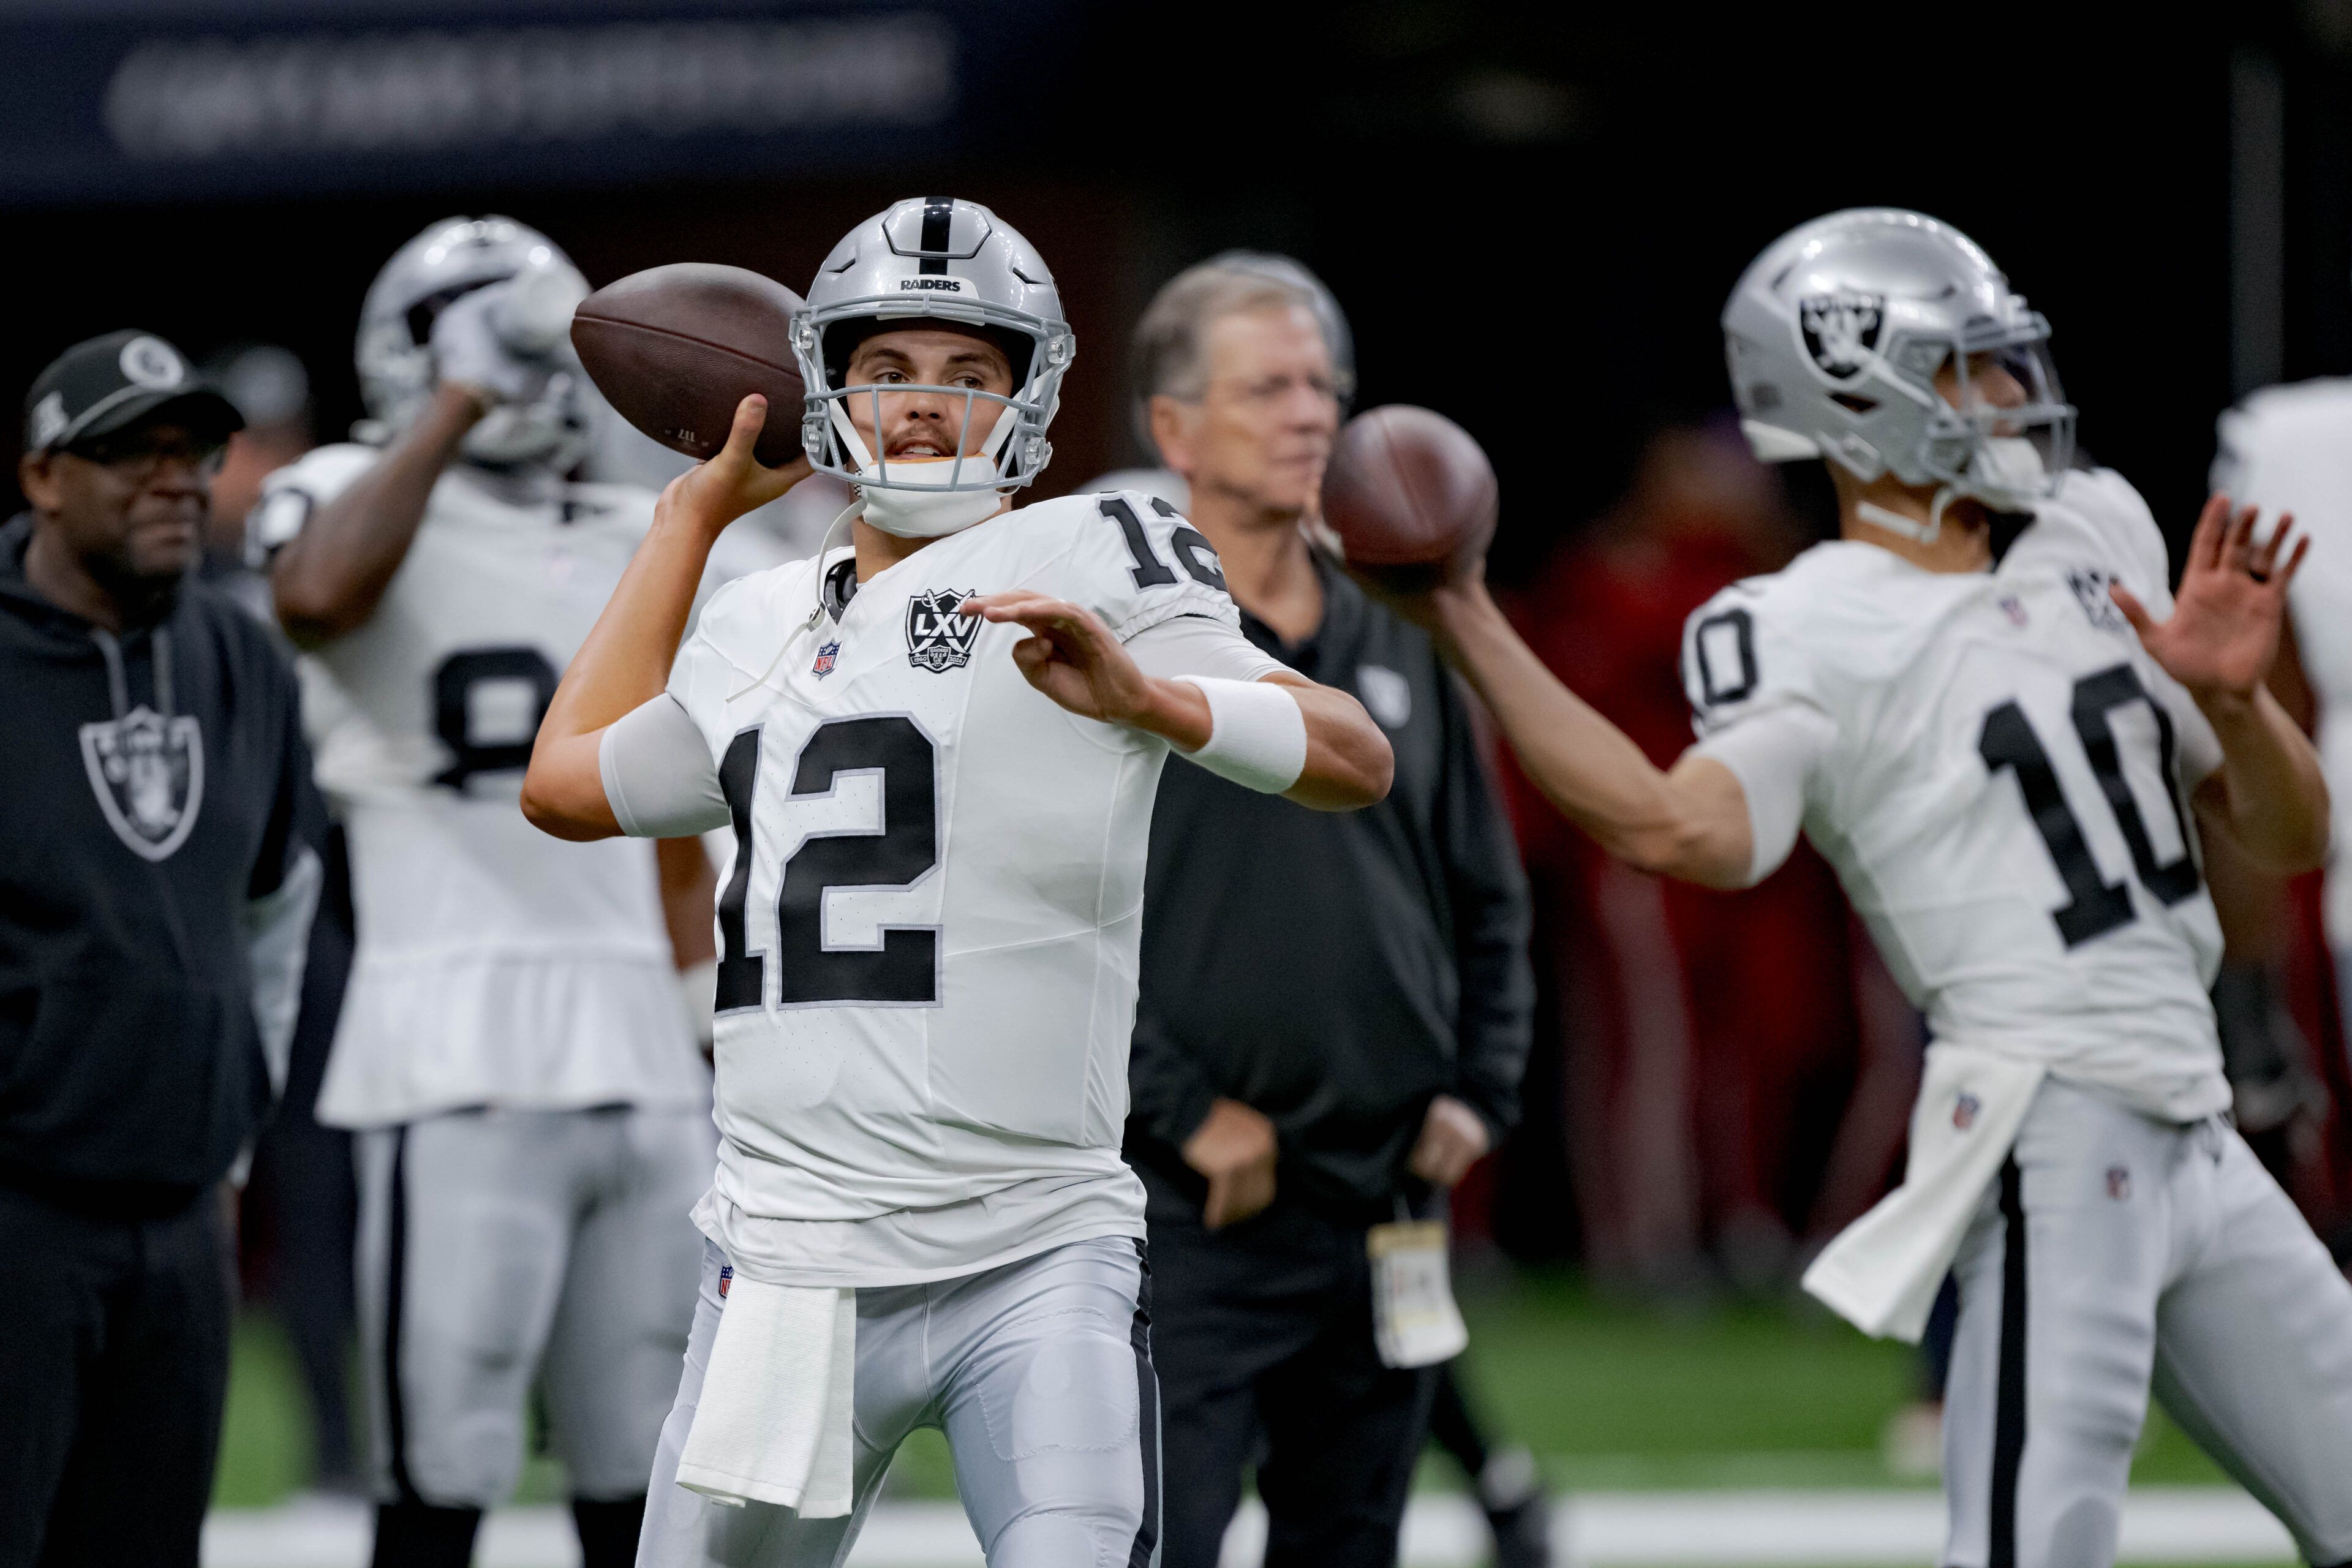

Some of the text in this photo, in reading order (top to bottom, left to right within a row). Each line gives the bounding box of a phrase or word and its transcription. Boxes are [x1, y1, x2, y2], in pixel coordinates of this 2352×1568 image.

[900, 279, 960, 292] RAIDERS
[1095, 496, 1230, 594] 12
[814, 655, 833, 671] NFL
[914, 613, 974, 637] LXV
[1682, 606, 1759, 710] 0
[1977, 663, 2201, 951] 10
[715, 712, 943, 1017] 12
